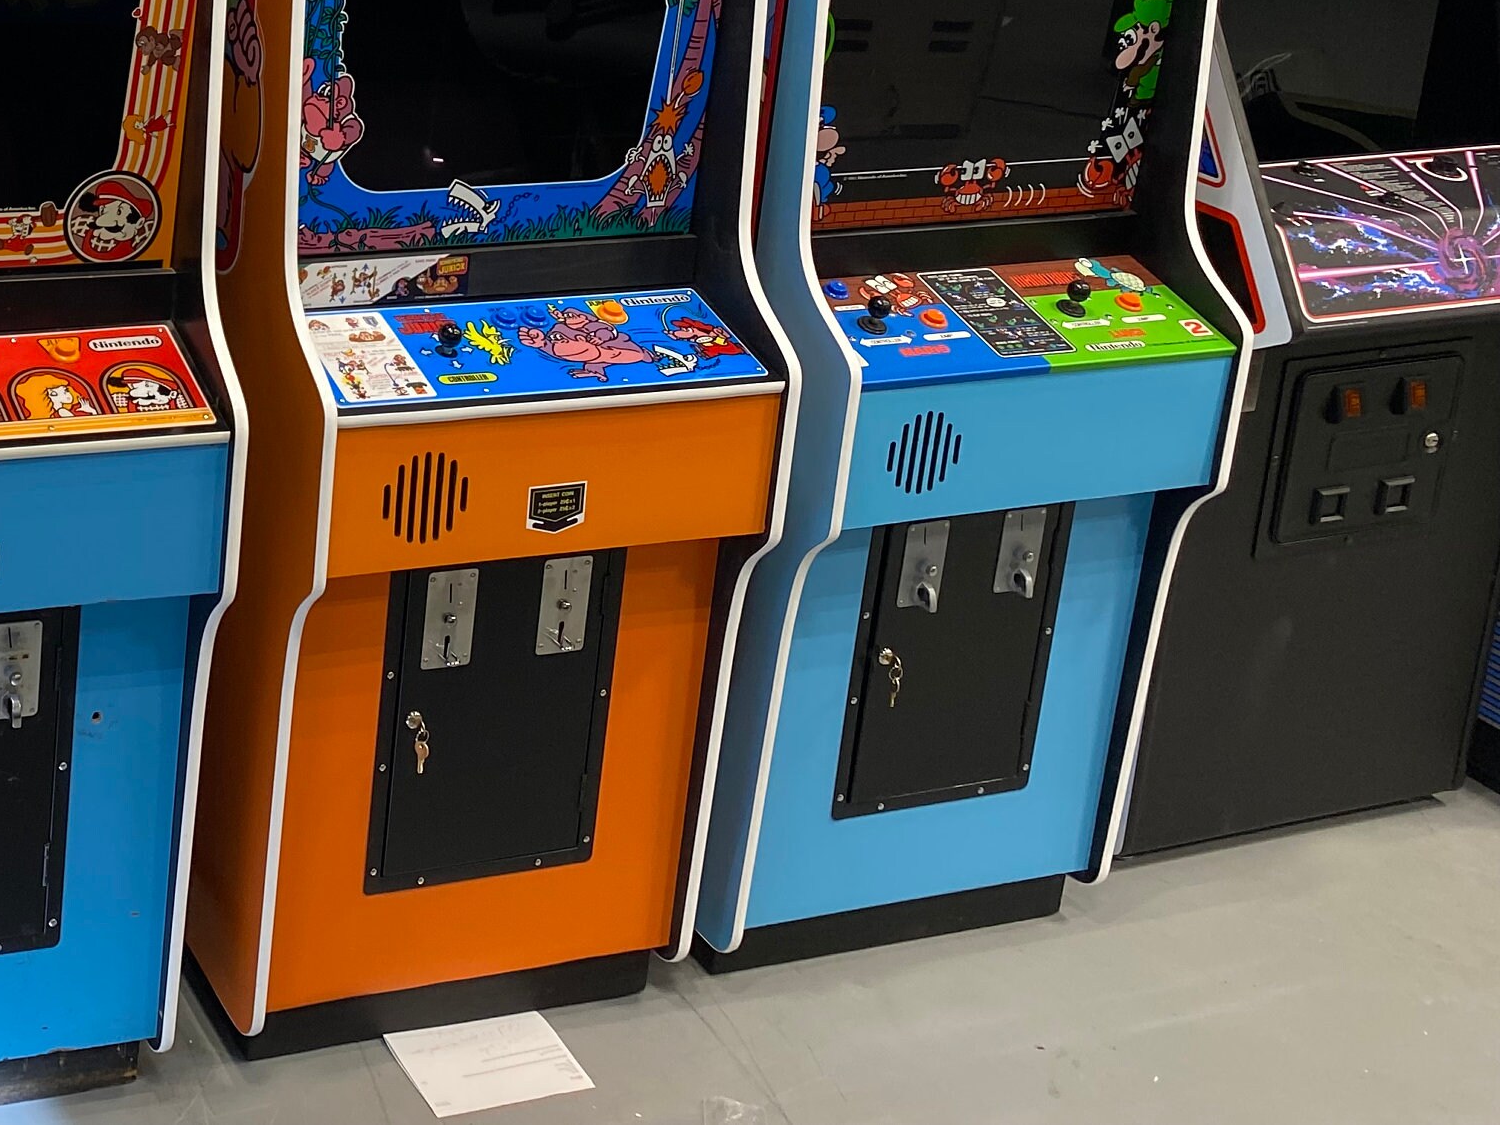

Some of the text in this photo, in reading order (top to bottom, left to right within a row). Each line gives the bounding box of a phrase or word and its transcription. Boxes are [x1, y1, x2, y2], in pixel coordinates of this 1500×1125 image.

[624, 294, 690, 306] Nintendo
[1184, 321, 1209, 334] 2
[92, 337, 160, 349] Nintendo
[1091, 341, 1143, 351] Nintendo
